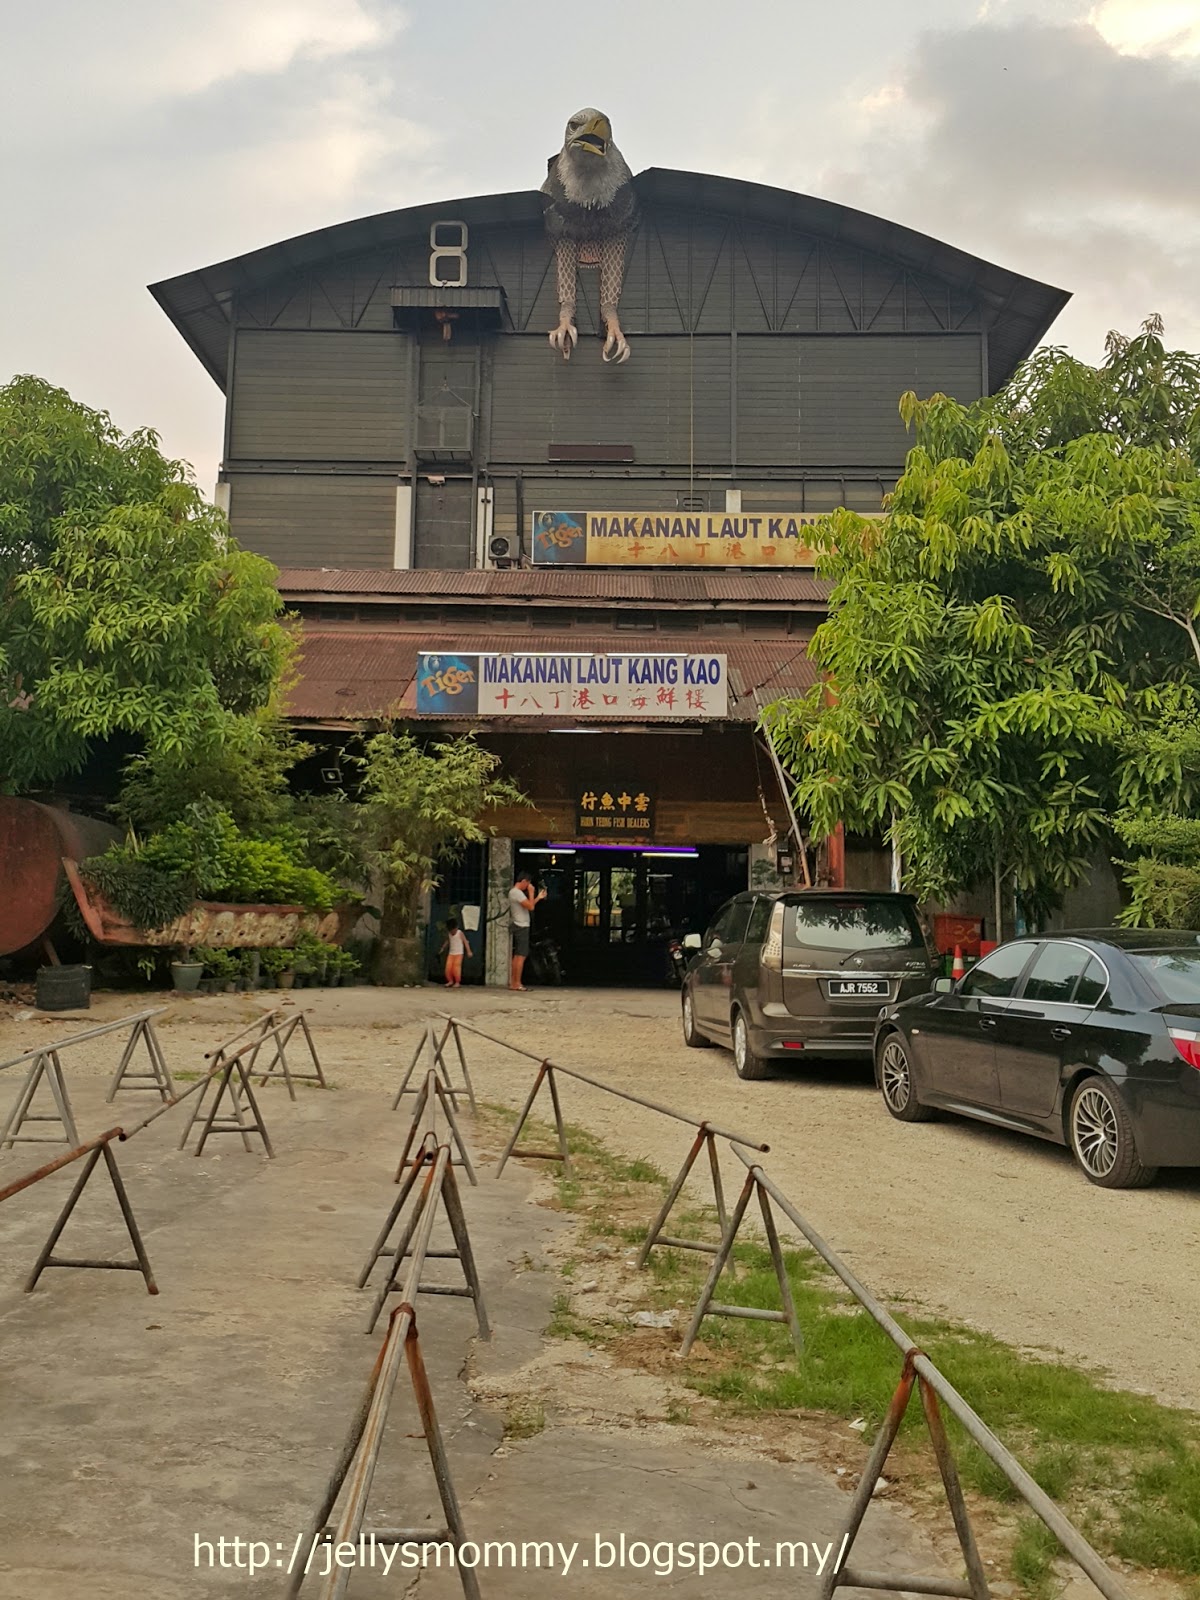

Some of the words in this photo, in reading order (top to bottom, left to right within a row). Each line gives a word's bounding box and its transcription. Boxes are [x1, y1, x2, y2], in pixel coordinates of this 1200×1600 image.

[536, 523, 584, 549] Tiger
[591, 517, 700, 538] MAKANAN
[707, 518, 762, 538] LAUT
[768, 518, 824, 539] KA
[421, 666, 476, 697] Tiger
[483, 657, 572, 684] MAKANAN
[577, 658, 622, 684] LAUT
[628, 658, 678, 684] KANG
[683, 658, 720, 685] KAO
[840, 983, 856, 993] AJR
[856, 983, 879, 993] 7552
